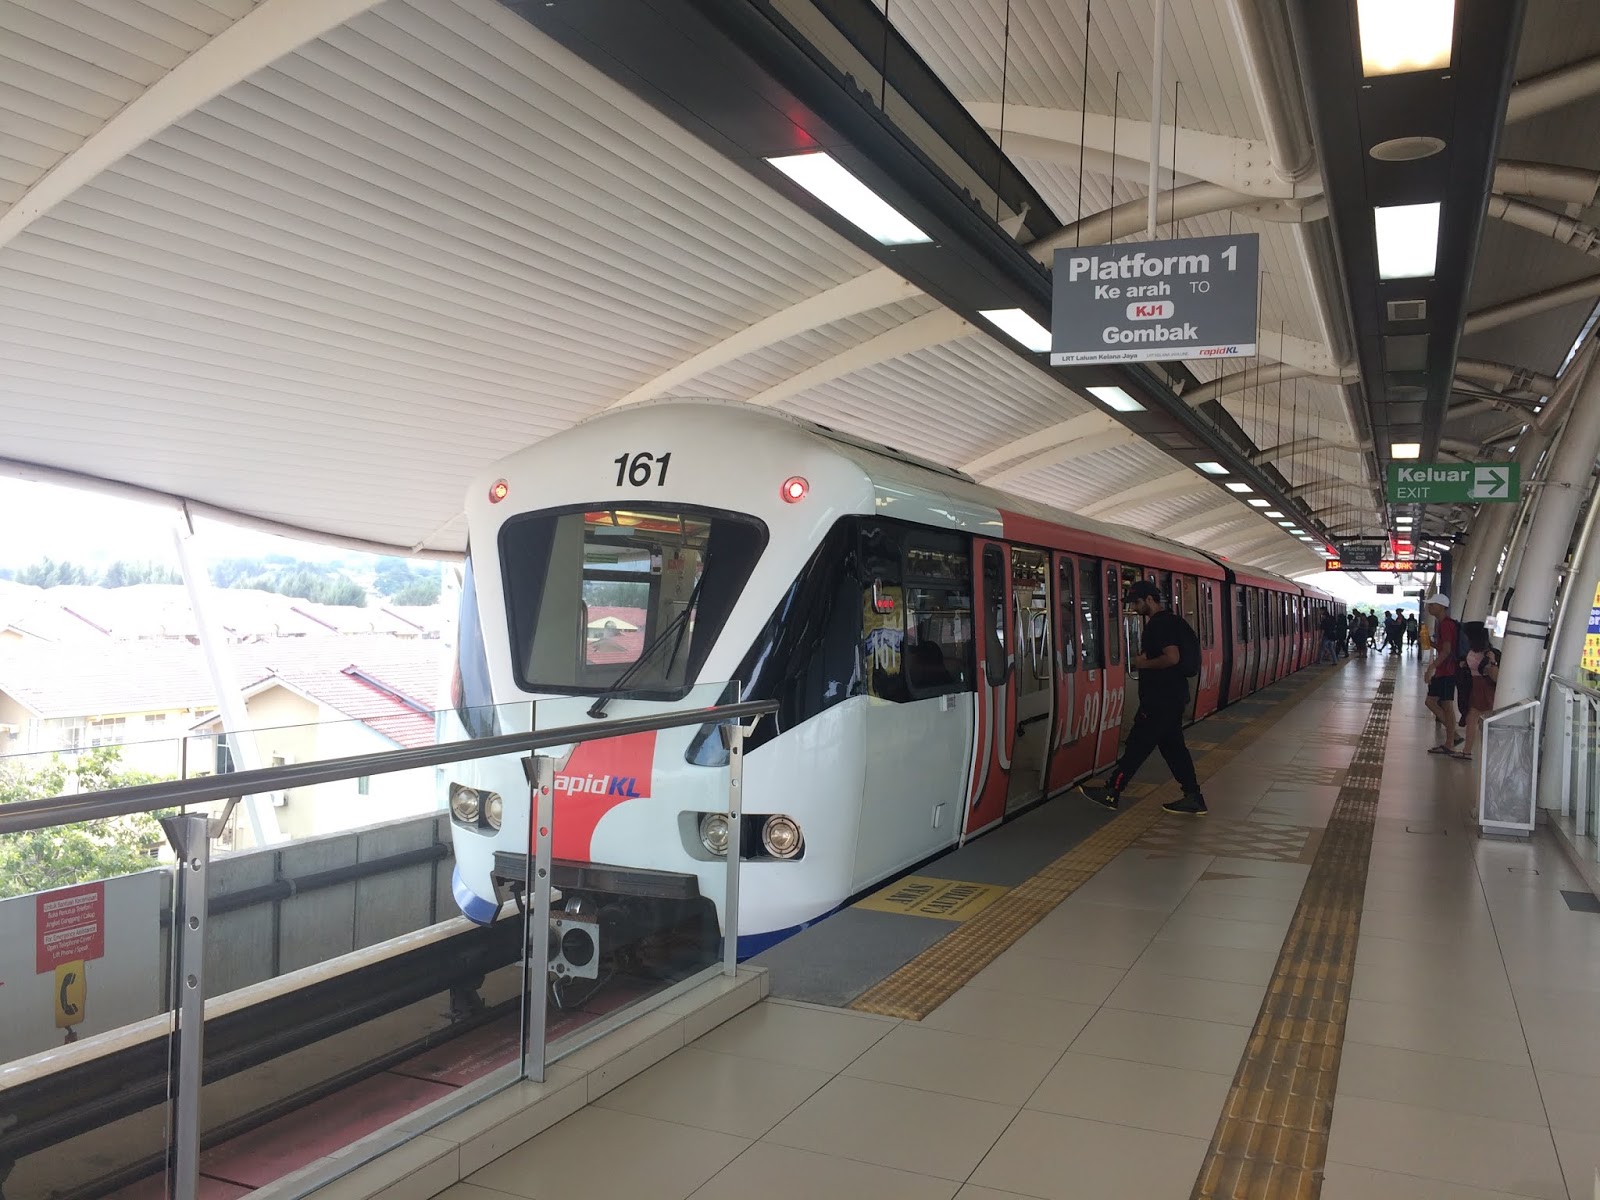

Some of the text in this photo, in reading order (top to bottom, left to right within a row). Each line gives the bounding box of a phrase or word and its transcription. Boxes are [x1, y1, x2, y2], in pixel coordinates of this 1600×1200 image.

[1069, 245, 1238, 282] Platform 1
[1094, 280, 1210, 300] Ke arah TO
[1135, 304, 1163, 317] KJ1
[1102, 322, 1199, 344] Gombak
[1199, 346, 1239, 356] rapidKL
[613, 451, 672, 487] 161
[1397, 467, 1470, 483] Keluar
[1397, 487, 1431, 499] EXIT
[554, 774, 641, 798] apidKL
[885, 883, 934, 905] AWAS
[920, 885, 982, 914] CAUTION
